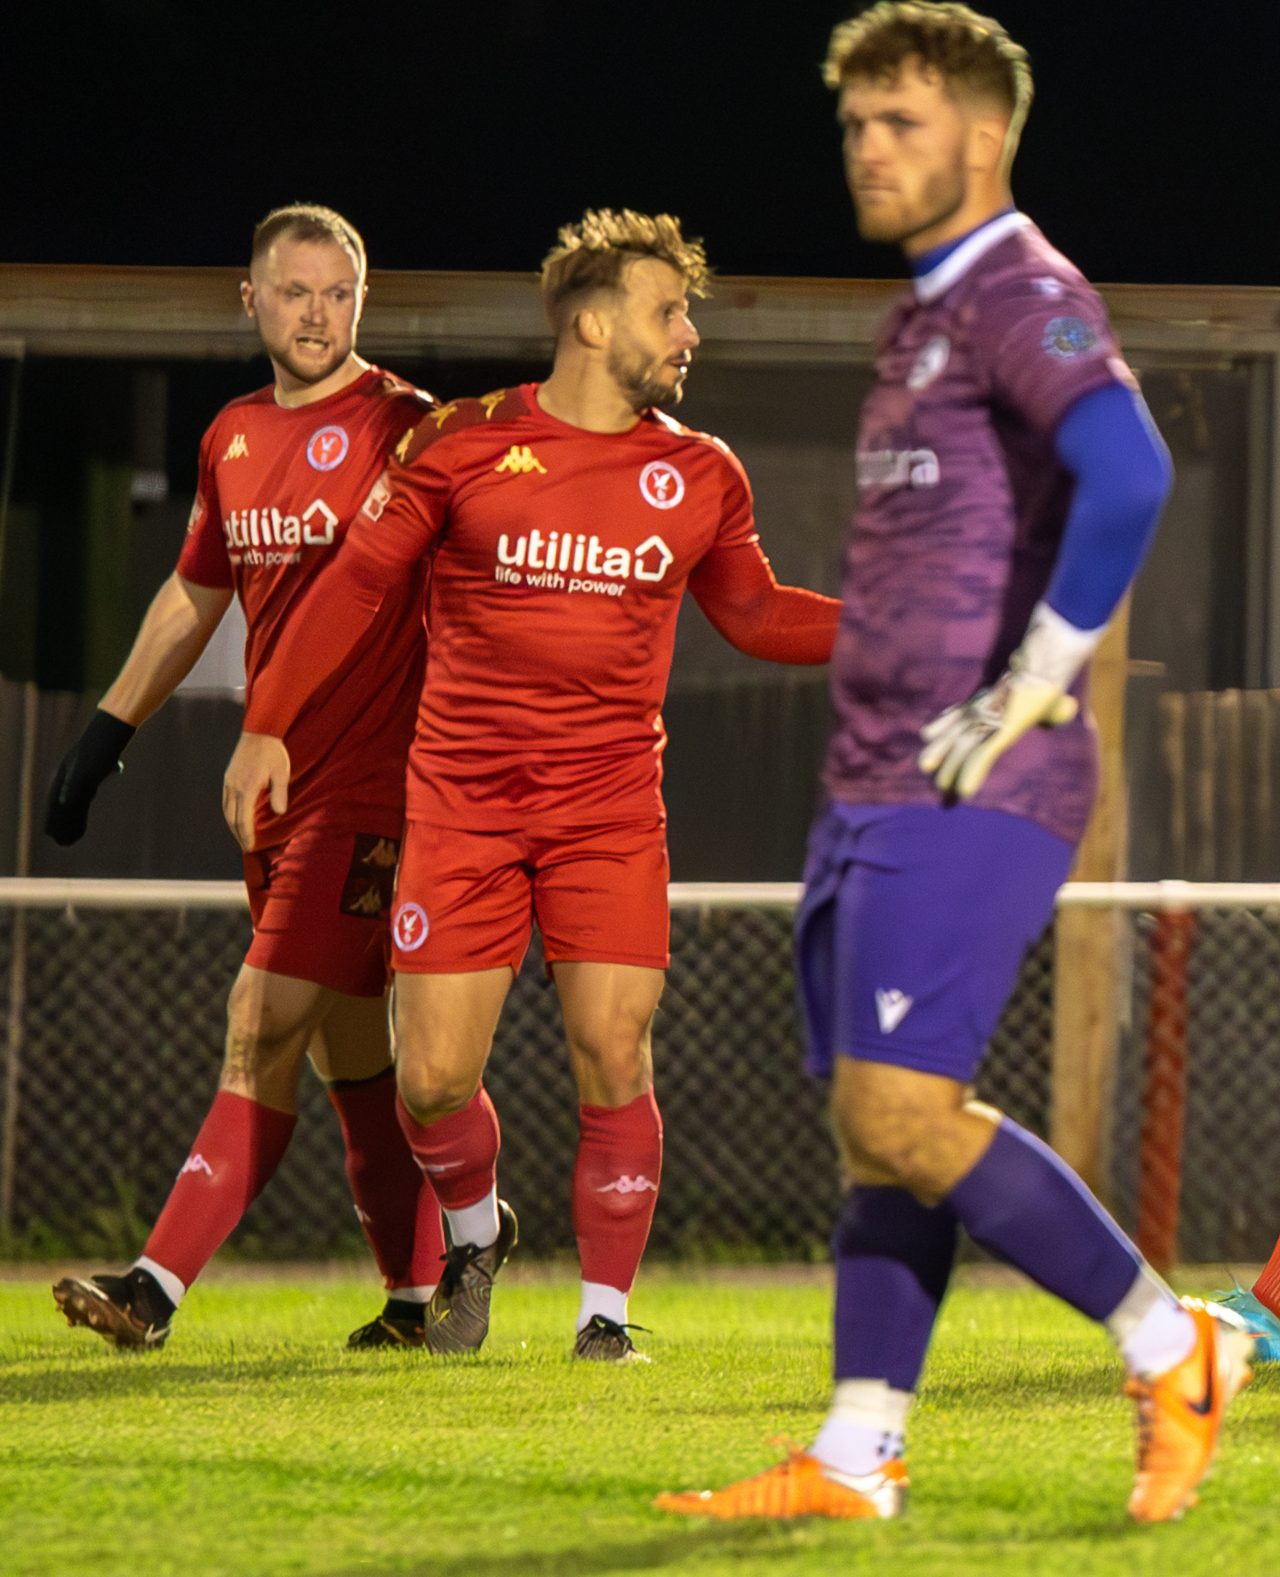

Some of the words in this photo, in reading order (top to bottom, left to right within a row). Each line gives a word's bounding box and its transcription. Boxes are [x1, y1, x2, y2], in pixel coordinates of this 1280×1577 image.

[497, 529, 631, 579] utilita
[495, 565, 522, 585] life
[526, 571, 565, 590] with
[568, 577, 626, 597] power
